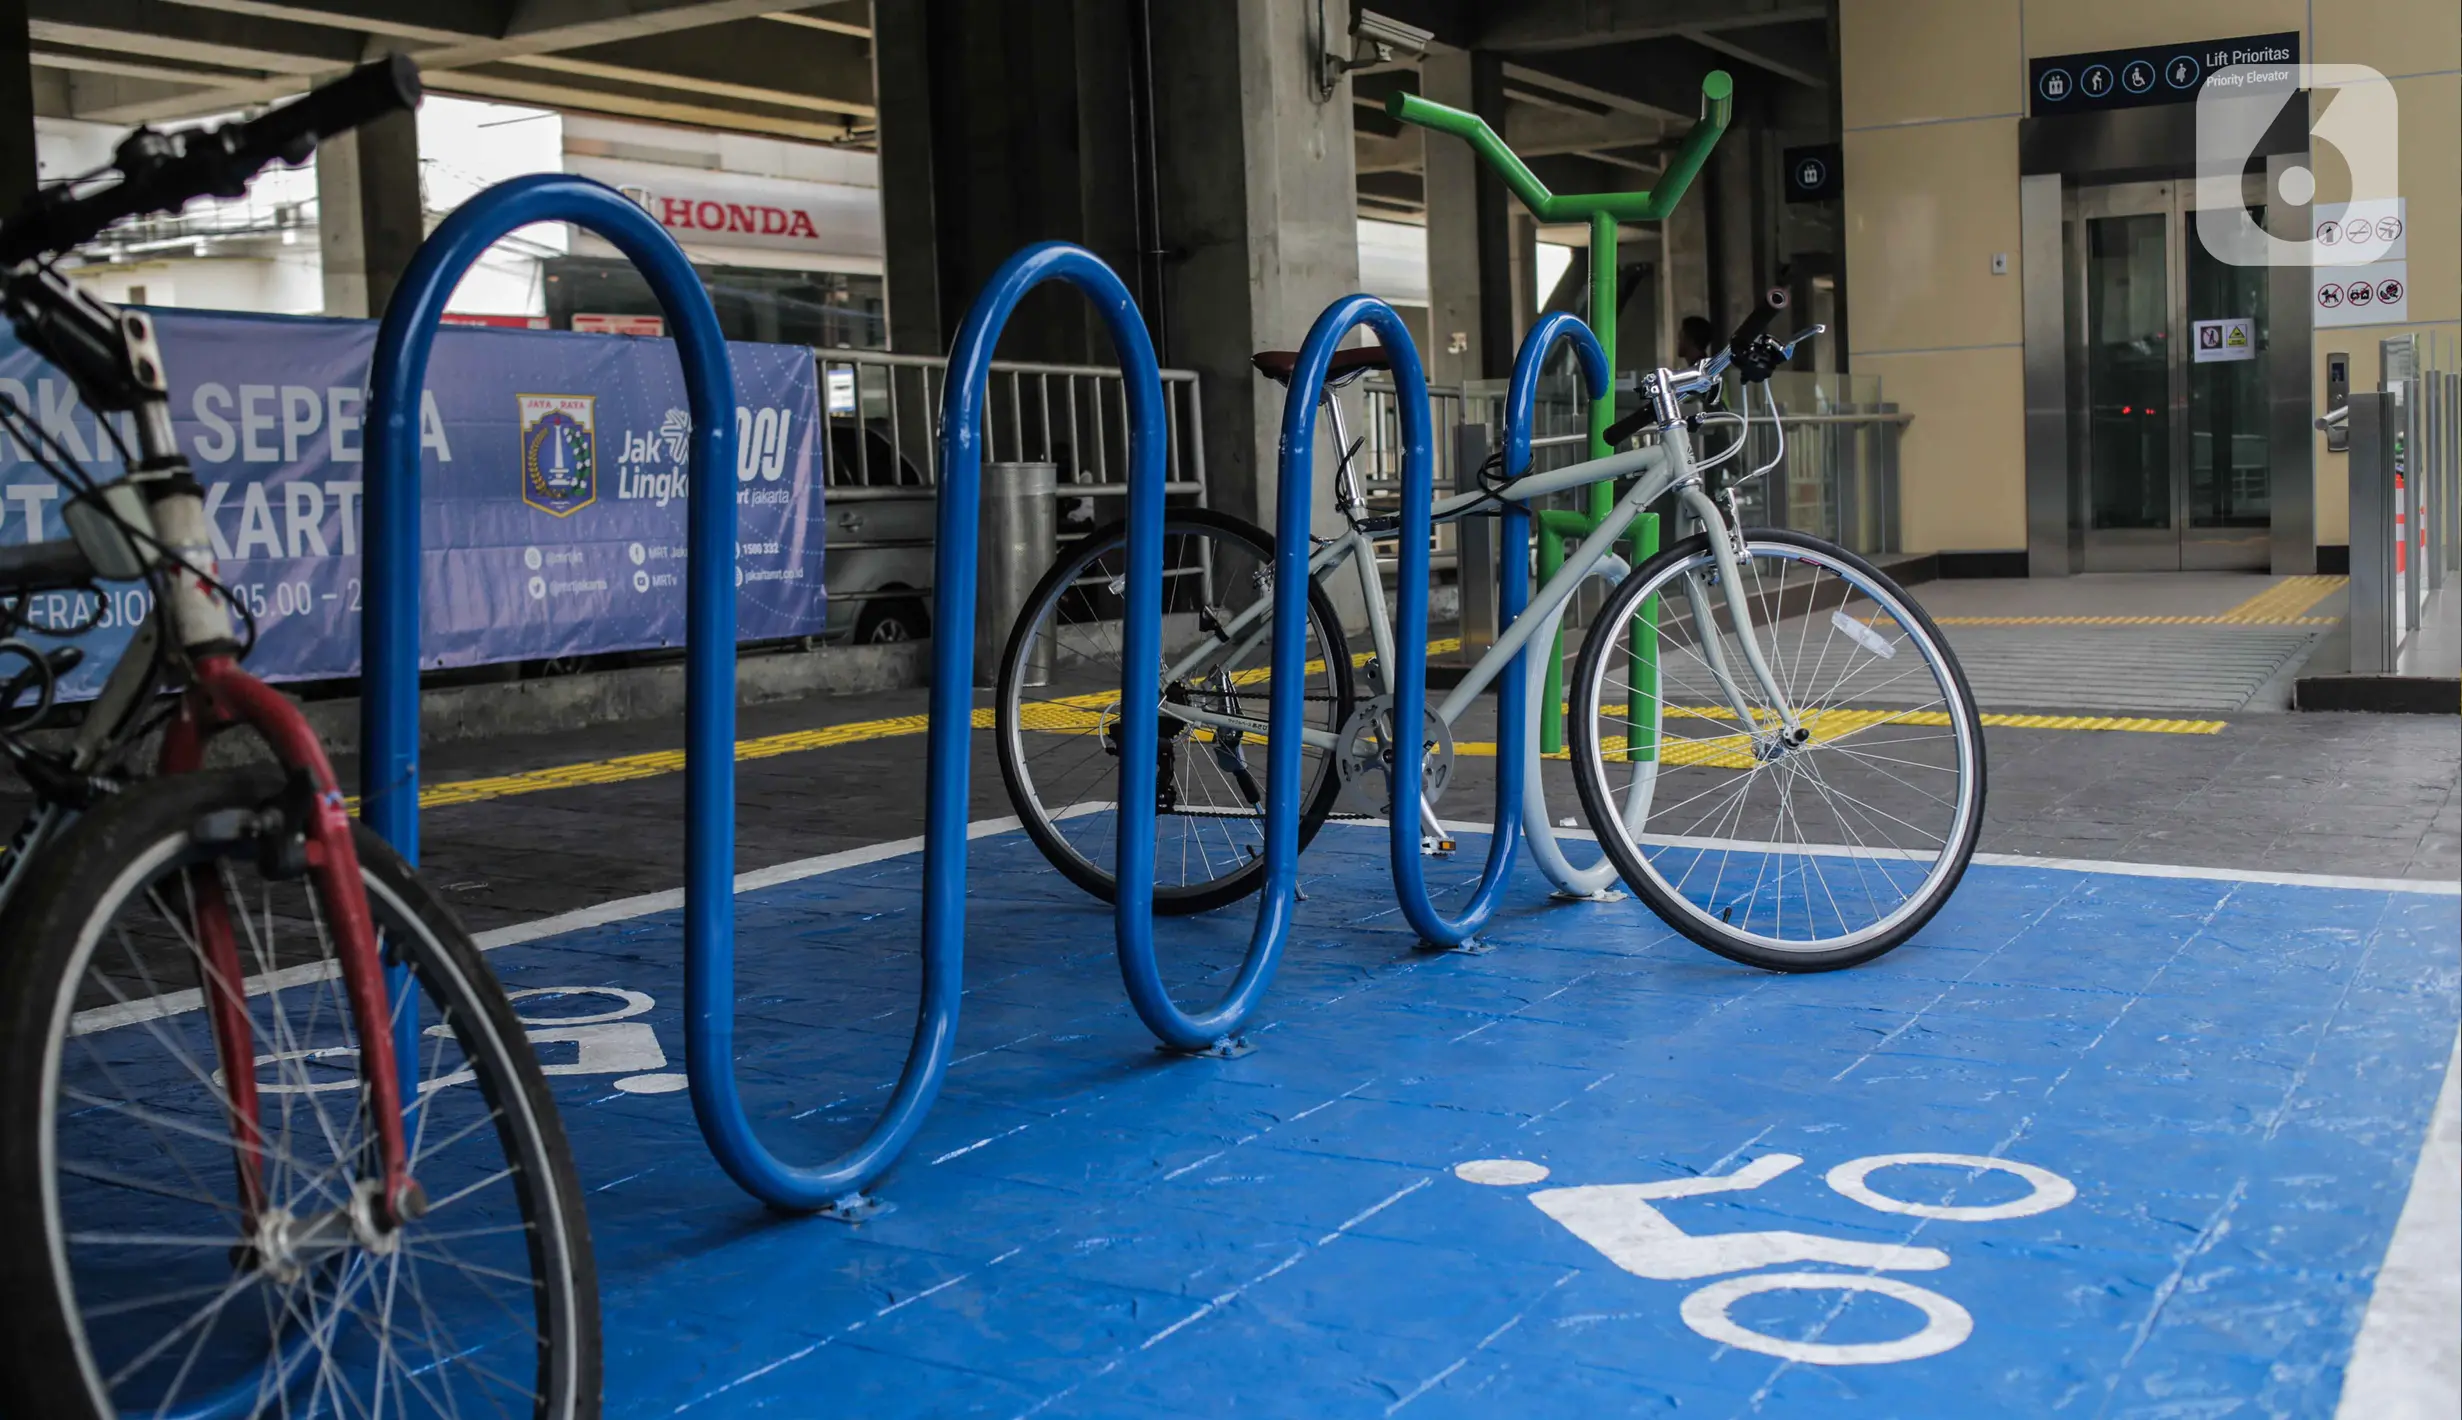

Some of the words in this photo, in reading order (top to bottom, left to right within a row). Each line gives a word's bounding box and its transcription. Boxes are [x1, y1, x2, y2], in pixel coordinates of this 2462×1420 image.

[2206, 51, 2228, 67] Lift
[2232, 46, 2290, 65] Prioritas
[2206, 73, 2244, 88] Priority
[2246, 70, 2289, 83] Elevator
[660, 197, 819, 239] HONDA
[527, 399, 552, 408] JAYA
[560, 400, 586, 409] RAYA
[192, 382, 452, 463] SEPEA
[617, 430, 662, 464] Jak
[618, 466, 688, 508] Lingk
[751, 488, 789, 507] jakarta
[203, 482, 363, 560] KART
[232, 581, 311, 620] 05.00
